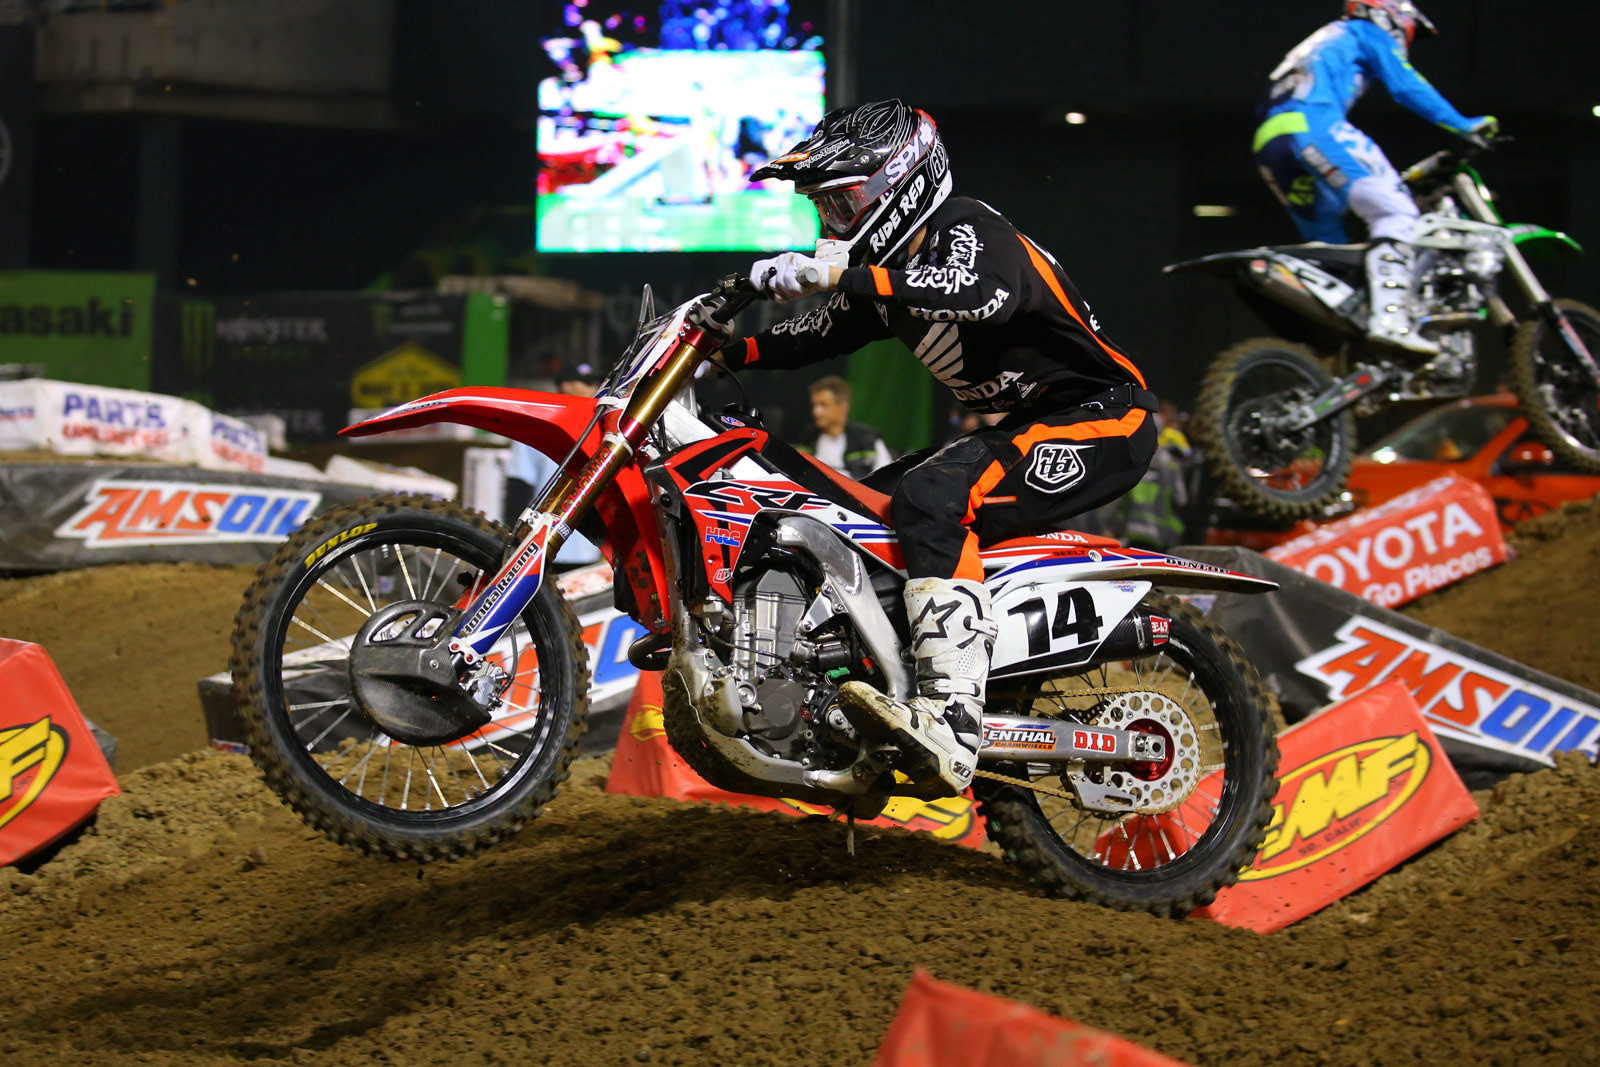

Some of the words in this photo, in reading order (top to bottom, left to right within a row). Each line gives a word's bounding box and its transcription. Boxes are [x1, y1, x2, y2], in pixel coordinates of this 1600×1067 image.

[869, 208, 902, 254] RIDE
[899, 174, 926, 216] RED
[907, 288, 1010, 322] HONDA
[951, 370, 1025, 401] ONDA
[63, 393, 165, 428] PARTS
[72, 488, 311, 540] AMSOIL
[705, 526, 741, 547] HRC
[304, 522, 378, 569] DUNLOP
[498, 542, 538, 591] Racing
[1164, 557, 1231, 574] DUNLOP
[1294, 502, 1483, 589] OYOTA
[1404, 546, 1493, 597] Places
[1007, 586, 1103, 657] 14
[1319, 627, 1600, 757] AMSOIL
[983, 727, 1056, 744] ENTHAL
[995, 741, 1053, 750] CHAINWHEELS
